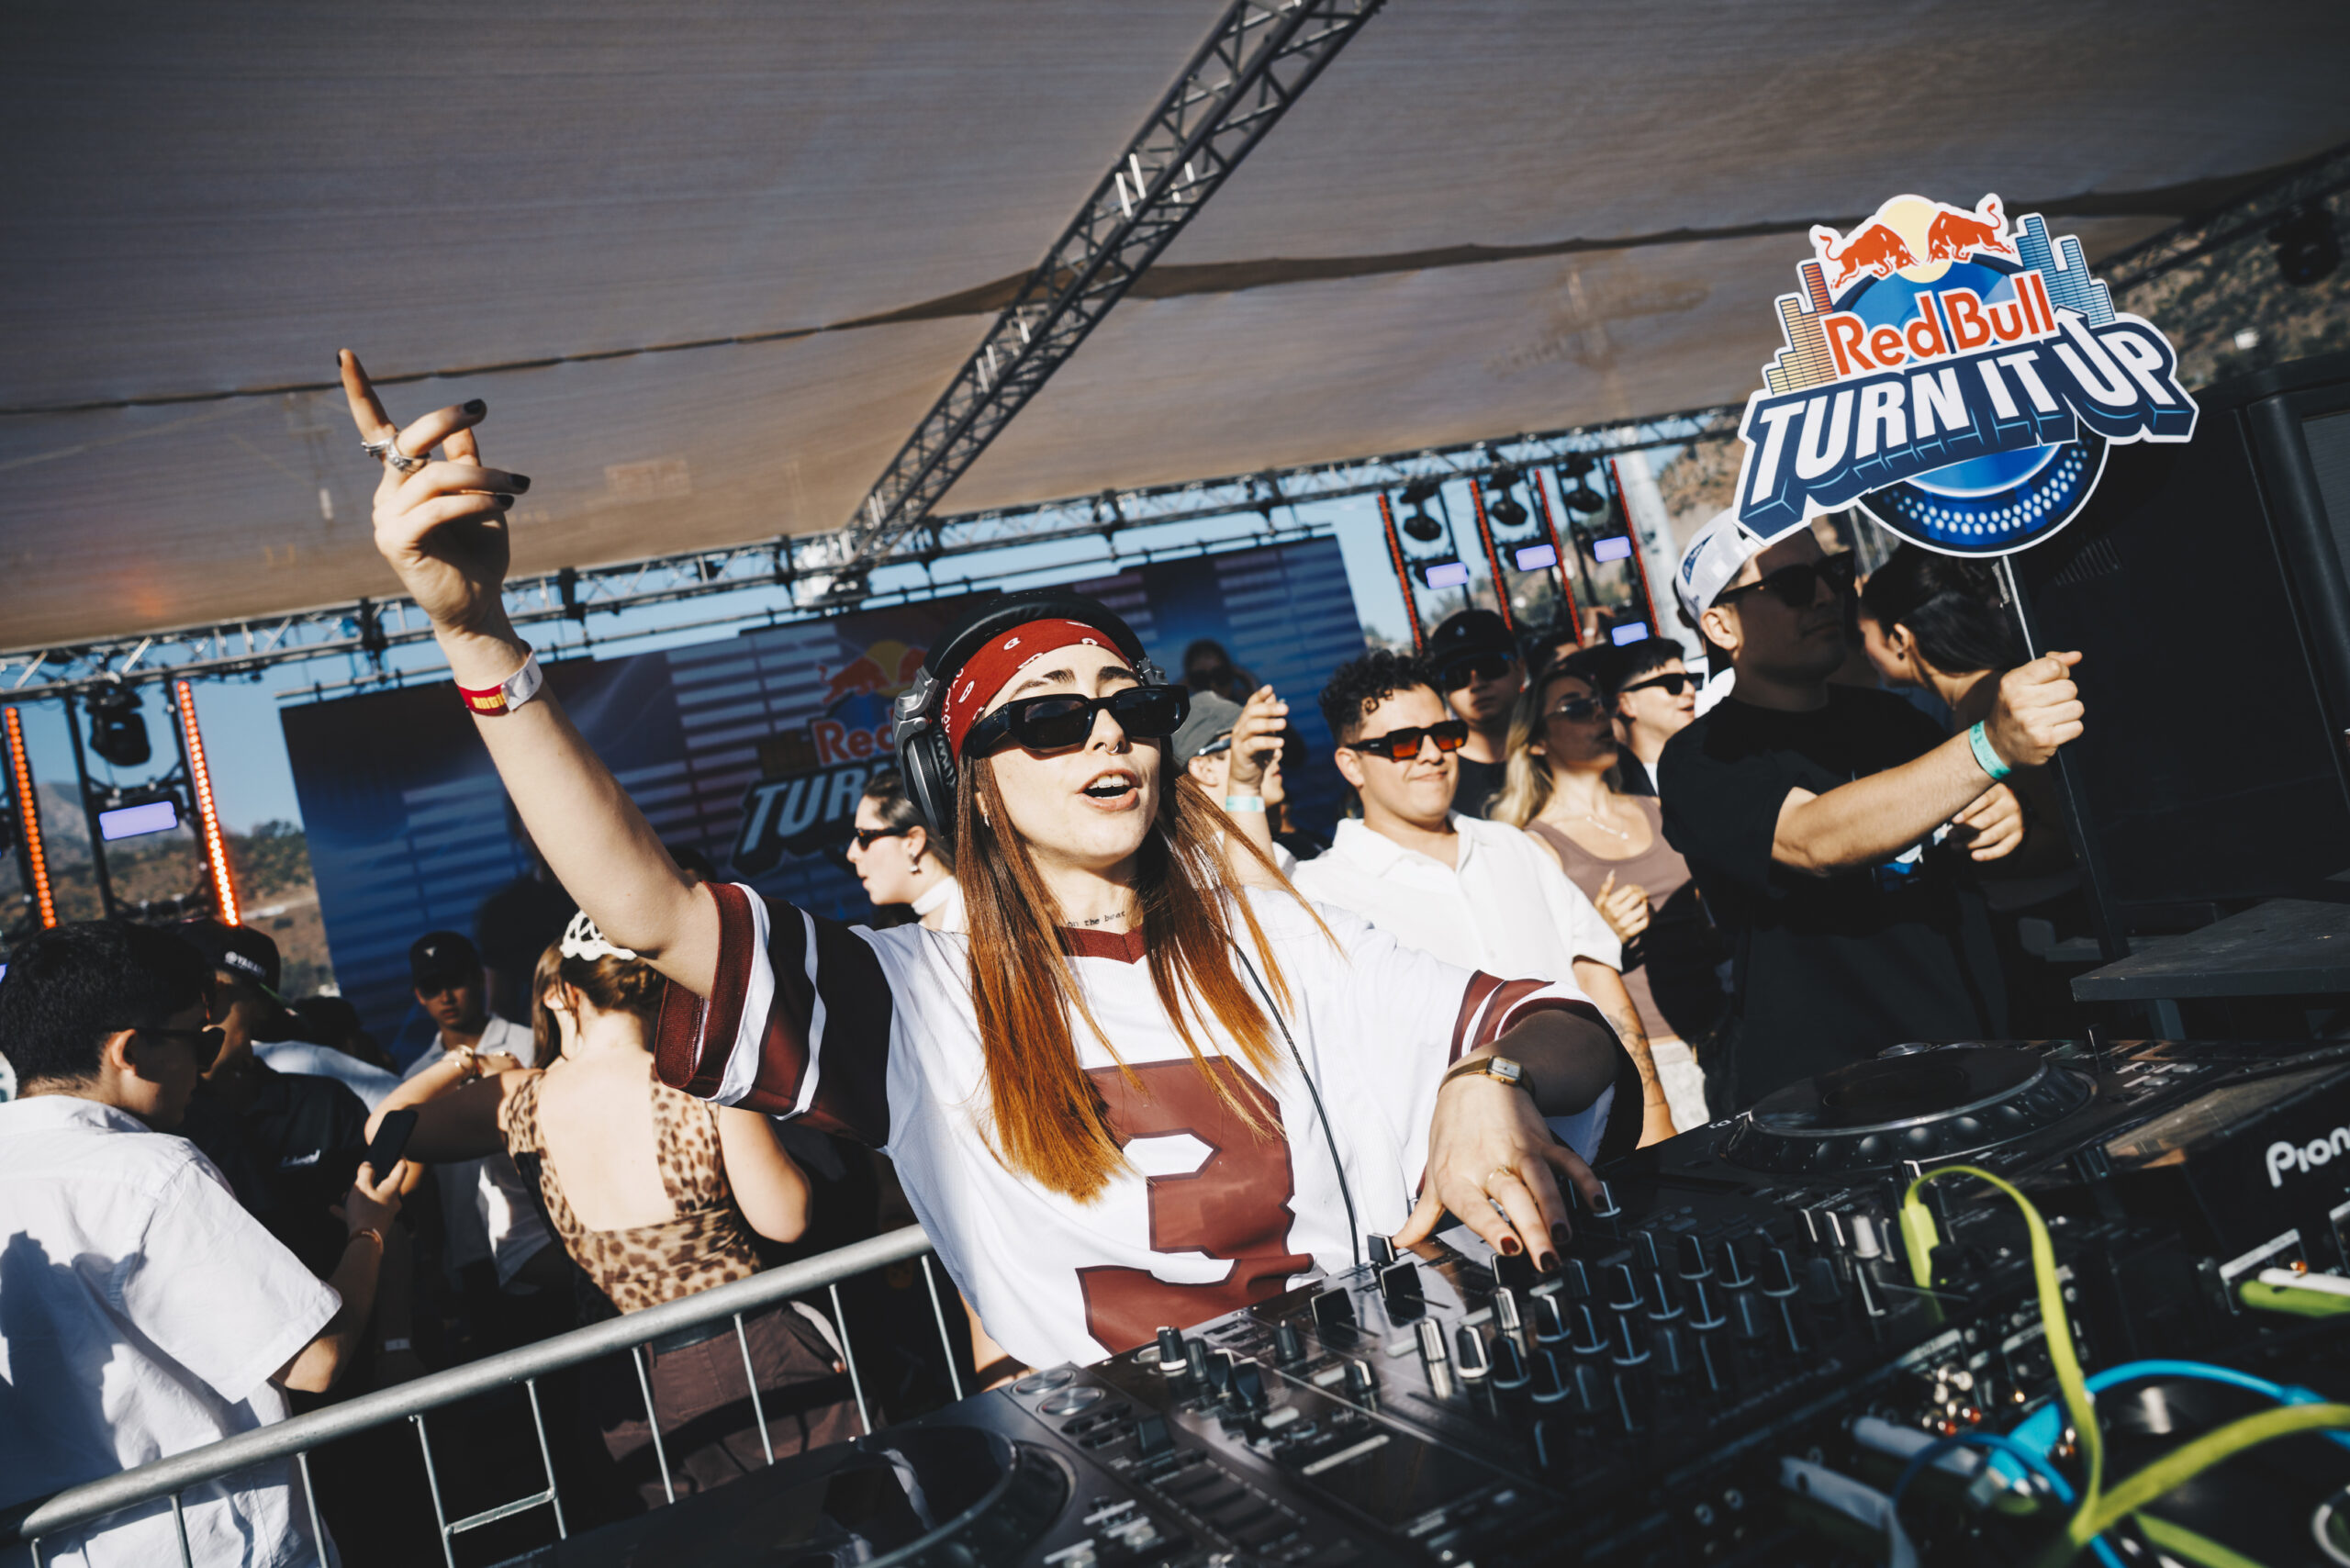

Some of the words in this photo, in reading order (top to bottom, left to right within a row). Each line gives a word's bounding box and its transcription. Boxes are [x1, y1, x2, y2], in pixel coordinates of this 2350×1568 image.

[1825, 297, 1946, 375] Red
[1944, 274, 2056, 351] Bull
[1750, 367, 1970, 505] TURN
[1976, 350, 2059, 420] IT
[2053, 307, 2177, 407] UP
[742, 761, 901, 855] TUR
[1084, 918, 1100, 926] the
[2266, 1125, 2350, 1188] Pion
